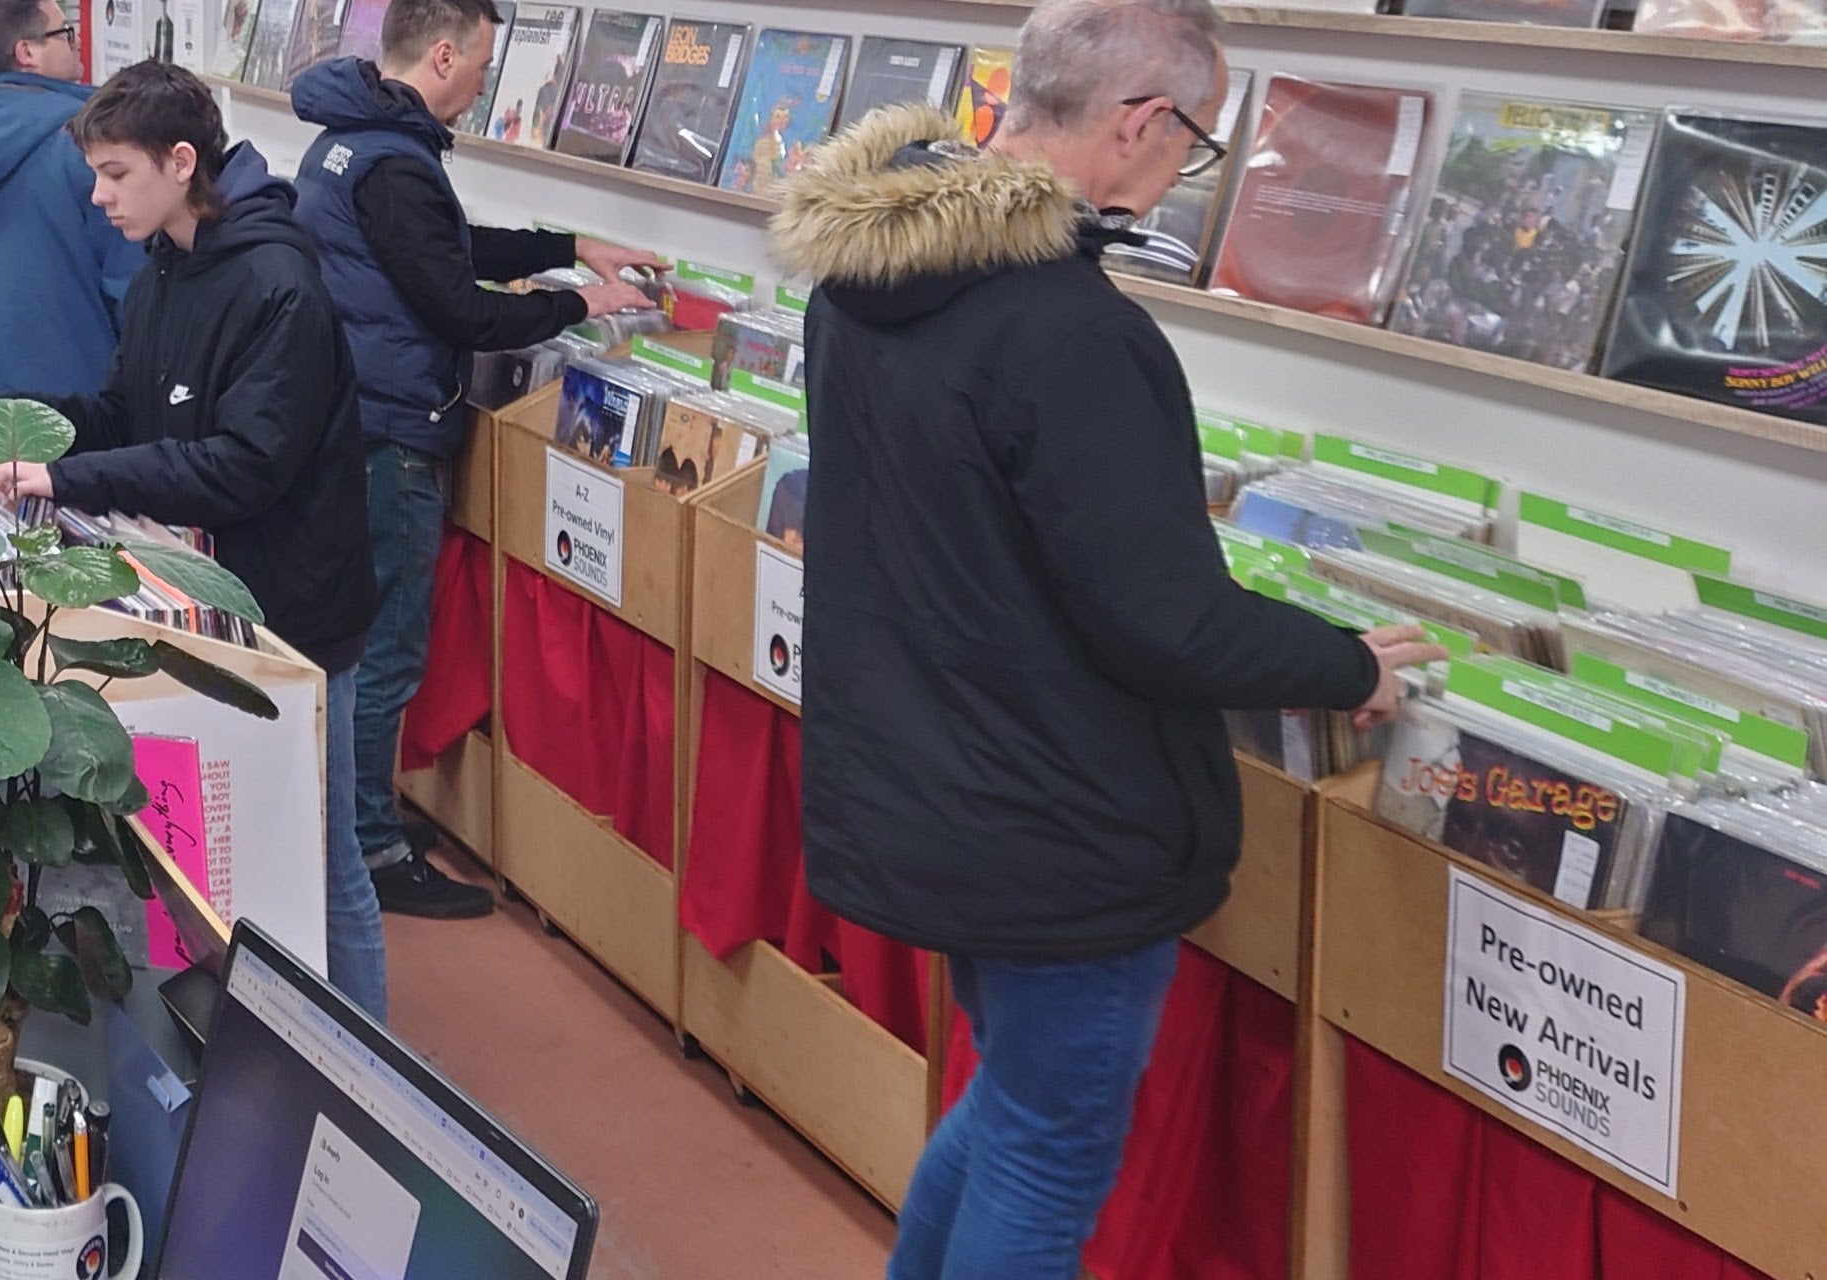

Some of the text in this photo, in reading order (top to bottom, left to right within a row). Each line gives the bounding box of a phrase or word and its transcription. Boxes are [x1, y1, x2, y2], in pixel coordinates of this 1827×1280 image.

[544, 9, 564, 21] ree
[671, 25, 698, 46] LEON
[664, 42, 711, 65] BRIDGES
[573, 80, 635, 115] ULTRA
[575, 484, 590, 503] A-Z
[552, 499, 615, 544] Pre-owned Vinyl
[573, 537, 608, 569] PHOENIX
[573, 557, 608, 588] SOUNDS
[771, 600, 803, 624] Pre-ow
[207, 760, 231, 769] SAW
[210, 782, 231, 791] YOU
[1401, 756, 1621, 831] Joe's Garage
[1479, 923, 1644, 1030] Pre-owned
[1465, 976, 1656, 1101] New Arrivals
[1536, 1058, 1611, 1115] PHOENIX
[1534, 1081, 1611, 1138] SOUNDS
